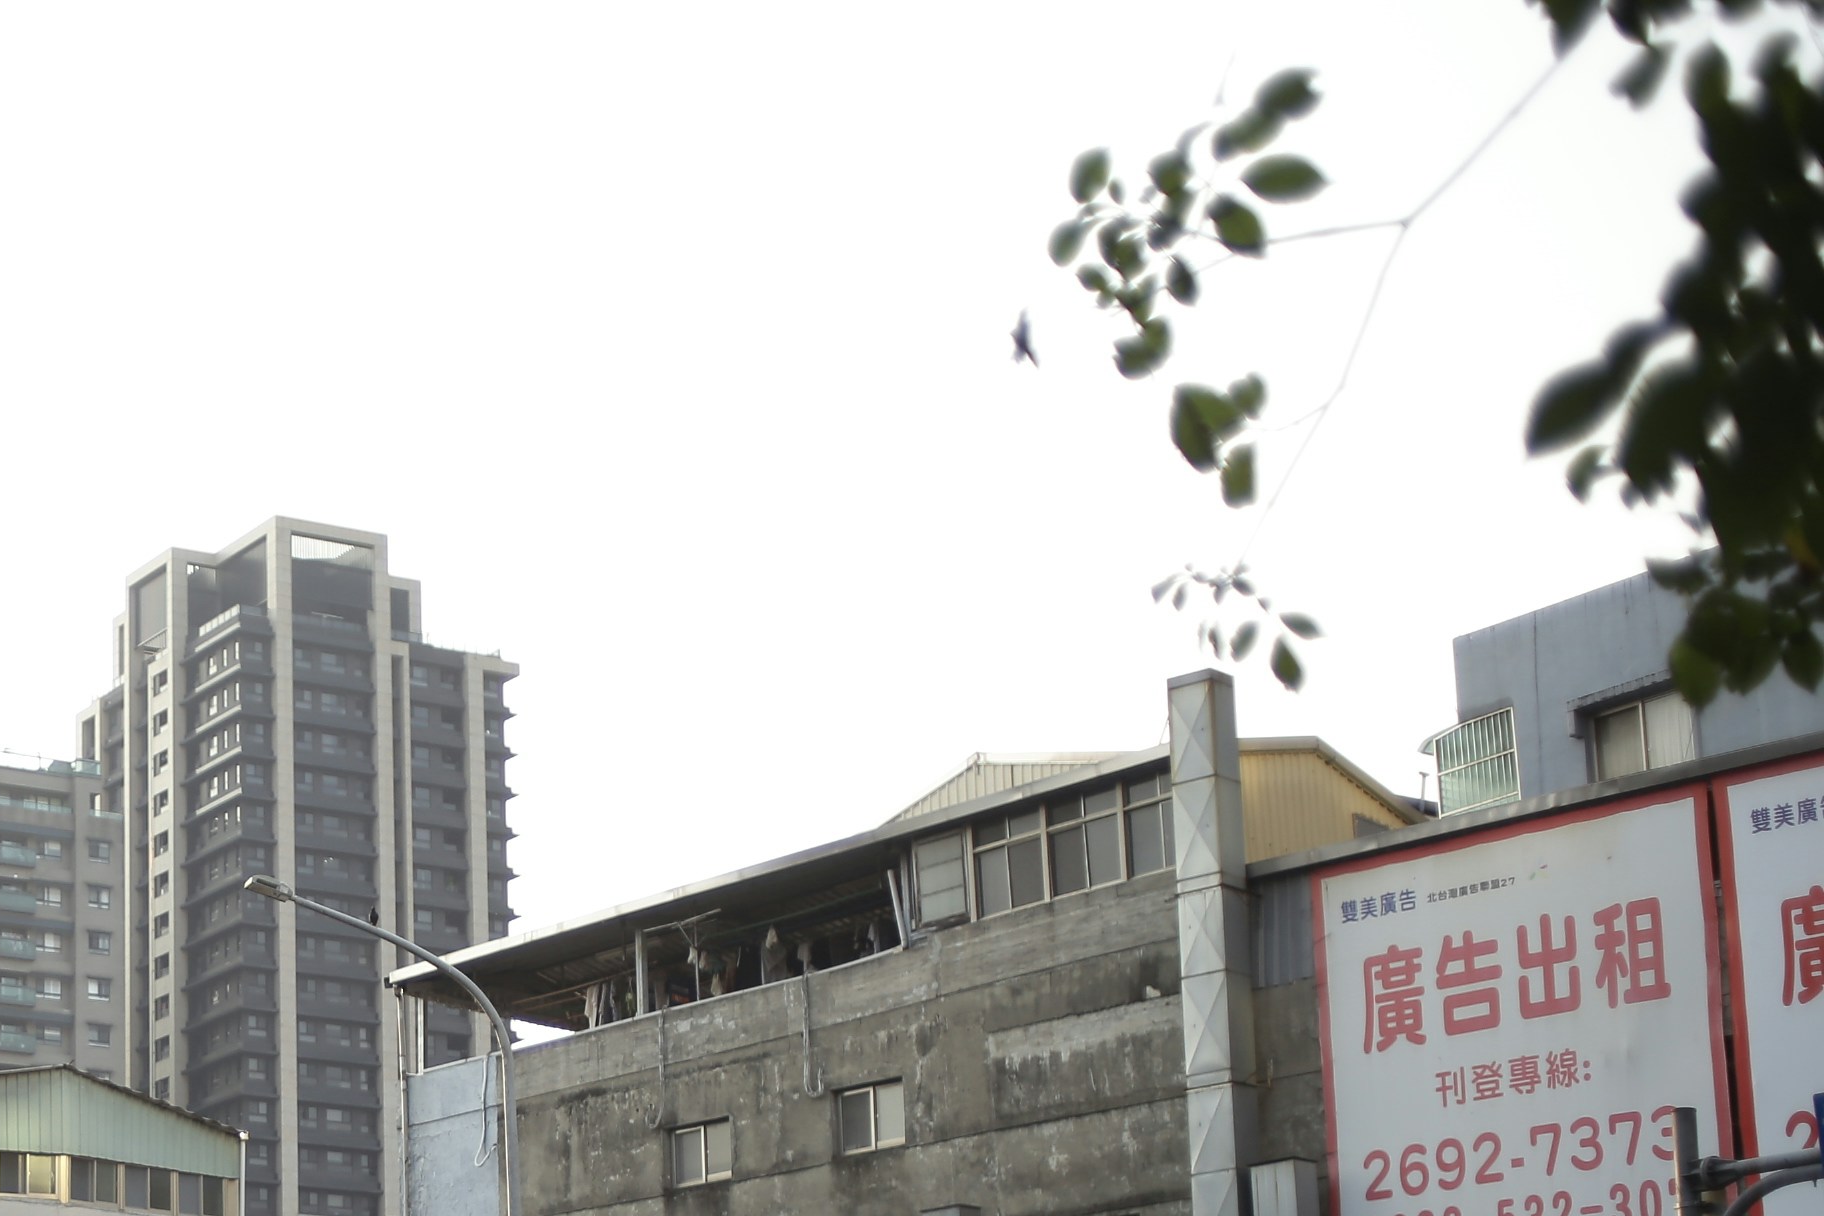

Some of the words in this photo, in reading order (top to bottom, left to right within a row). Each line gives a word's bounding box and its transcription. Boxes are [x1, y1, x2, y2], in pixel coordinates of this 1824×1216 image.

[1750, 798, 1824, 834] 雙美廣
[1341, 888, 1417, 923] 雙美廣告
[1427, 877, 1516, 903] 北台灣廣告聯盟27
[1363, 896, 1671, 1055] 廣告出租
[1435, 1048, 1592, 1107] 刊登專線:
[1363, 1105, 1675, 1201] 2692-7373
